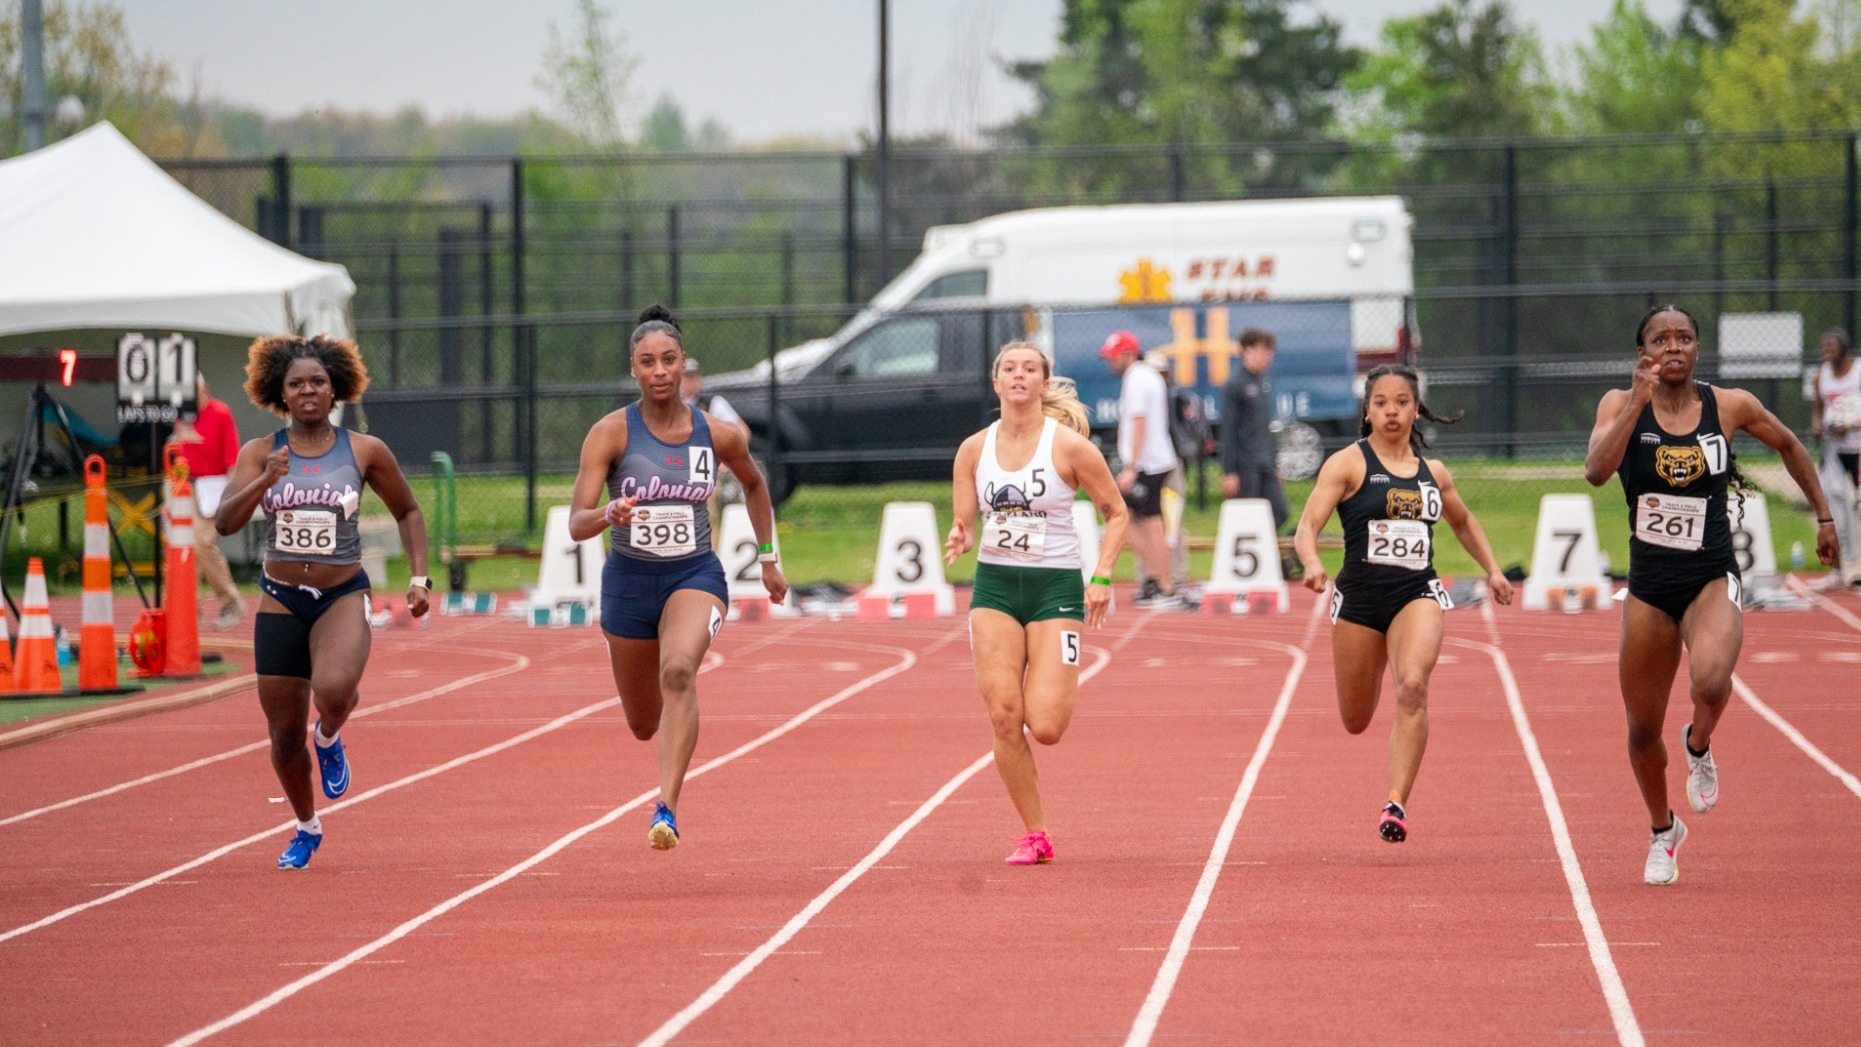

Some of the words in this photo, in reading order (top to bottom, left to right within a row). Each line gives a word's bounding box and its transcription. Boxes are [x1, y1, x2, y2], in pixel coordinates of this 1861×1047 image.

[1187, 256, 1276, 280] STAR
[59, 349, 77, 387] 7
[116, 405, 145, 423] LAPS
[145, 405, 161, 423] TO
[160, 404, 178, 423] GO
[695, 449, 711, 481] 4
[1706, 438, 1722, 471] 7
[1032, 467, 1046, 498] 5
[1427, 488, 1439, 518] 6
[280, 527, 331, 548] 386
[636, 523, 690, 546] 398
[997, 529, 1030, 551] 24
[1646, 513, 1694, 538] 261
[564, 543, 583, 584] 1
[735, 541, 761, 581] 2
[897, 540, 923, 582] 3
[1233, 535, 1258, 578] 5
[1373, 538, 1425, 558] 284
[1552, 531, 1582, 573] 7
[1731, 530, 1755, 572] 8
[1066, 633, 1078, 664] 5
